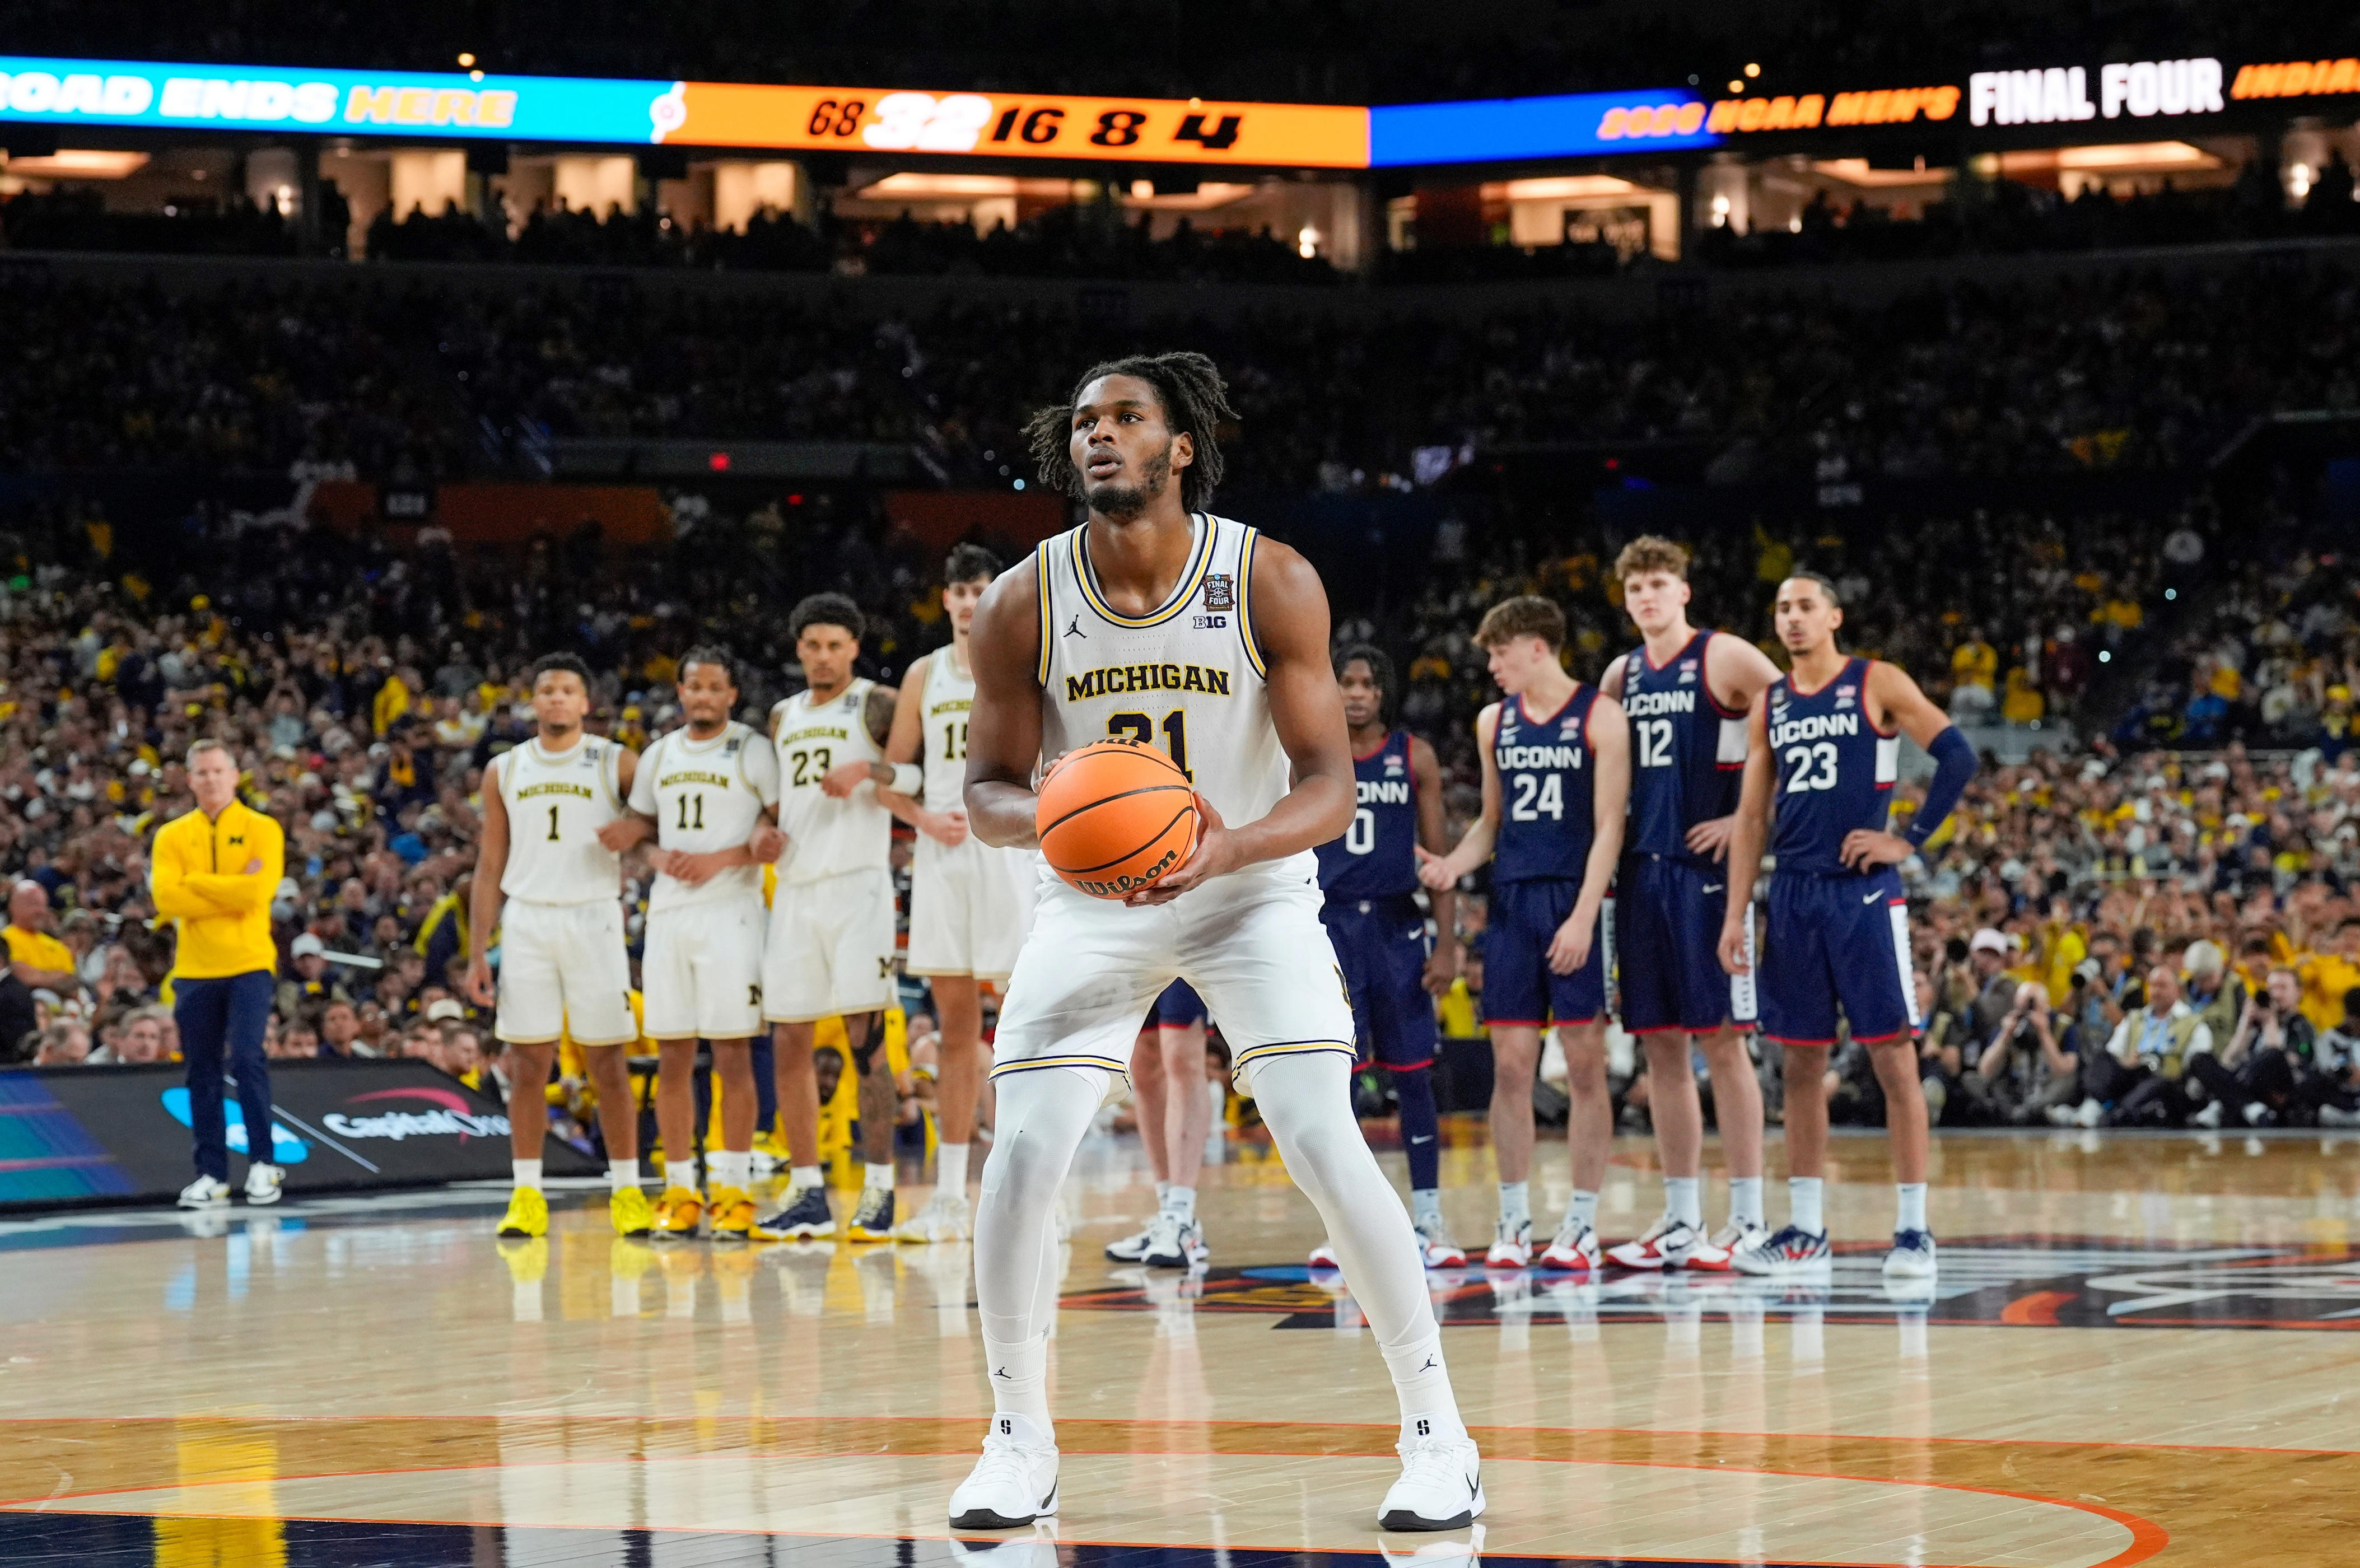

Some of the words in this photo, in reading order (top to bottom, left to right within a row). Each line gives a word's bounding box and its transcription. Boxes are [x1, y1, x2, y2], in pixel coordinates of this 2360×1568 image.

[0, 72, 153, 115] OAD
[159, 78, 339, 122] ENDS
[344, 85, 518, 128] HERE
[1706, 94, 1826, 133] NCAA
[1826, 86, 1961, 126] MEN'S
[1970, 67, 2096, 127] FINAL
[2101, 58, 2223, 118] FOUR
[2231, 58, 2360, 100] INDIA
[809, 101, 864, 136] 68
[862, 93, 993, 151] 32
[992, 108, 1065, 144] 16
[1090, 111, 1147, 146] 8
[1174, 114, 1242, 150] 4
[1209, 596, 1229, 605] FOUR
[1066, 663, 1230, 704] MICHIGAN
[1622, 690, 1695, 717] UCONN
[1636, 718, 1673, 768] 12
[1769, 713, 1858, 749] UCONN
[791, 748, 831, 787] 23
[1496, 745, 1583, 771] UCONN
[1785, 741, 1838, 793] 23
[677, 793, 704, 830] 11
[1356, 781, 1409, 805] ONN
[1513, 773, 1564, 822] 24
[548, 804, 560, 840] 1
[1346, 808, 1375, 855] 0
[1072, 849, 1178, 896] Wilson
